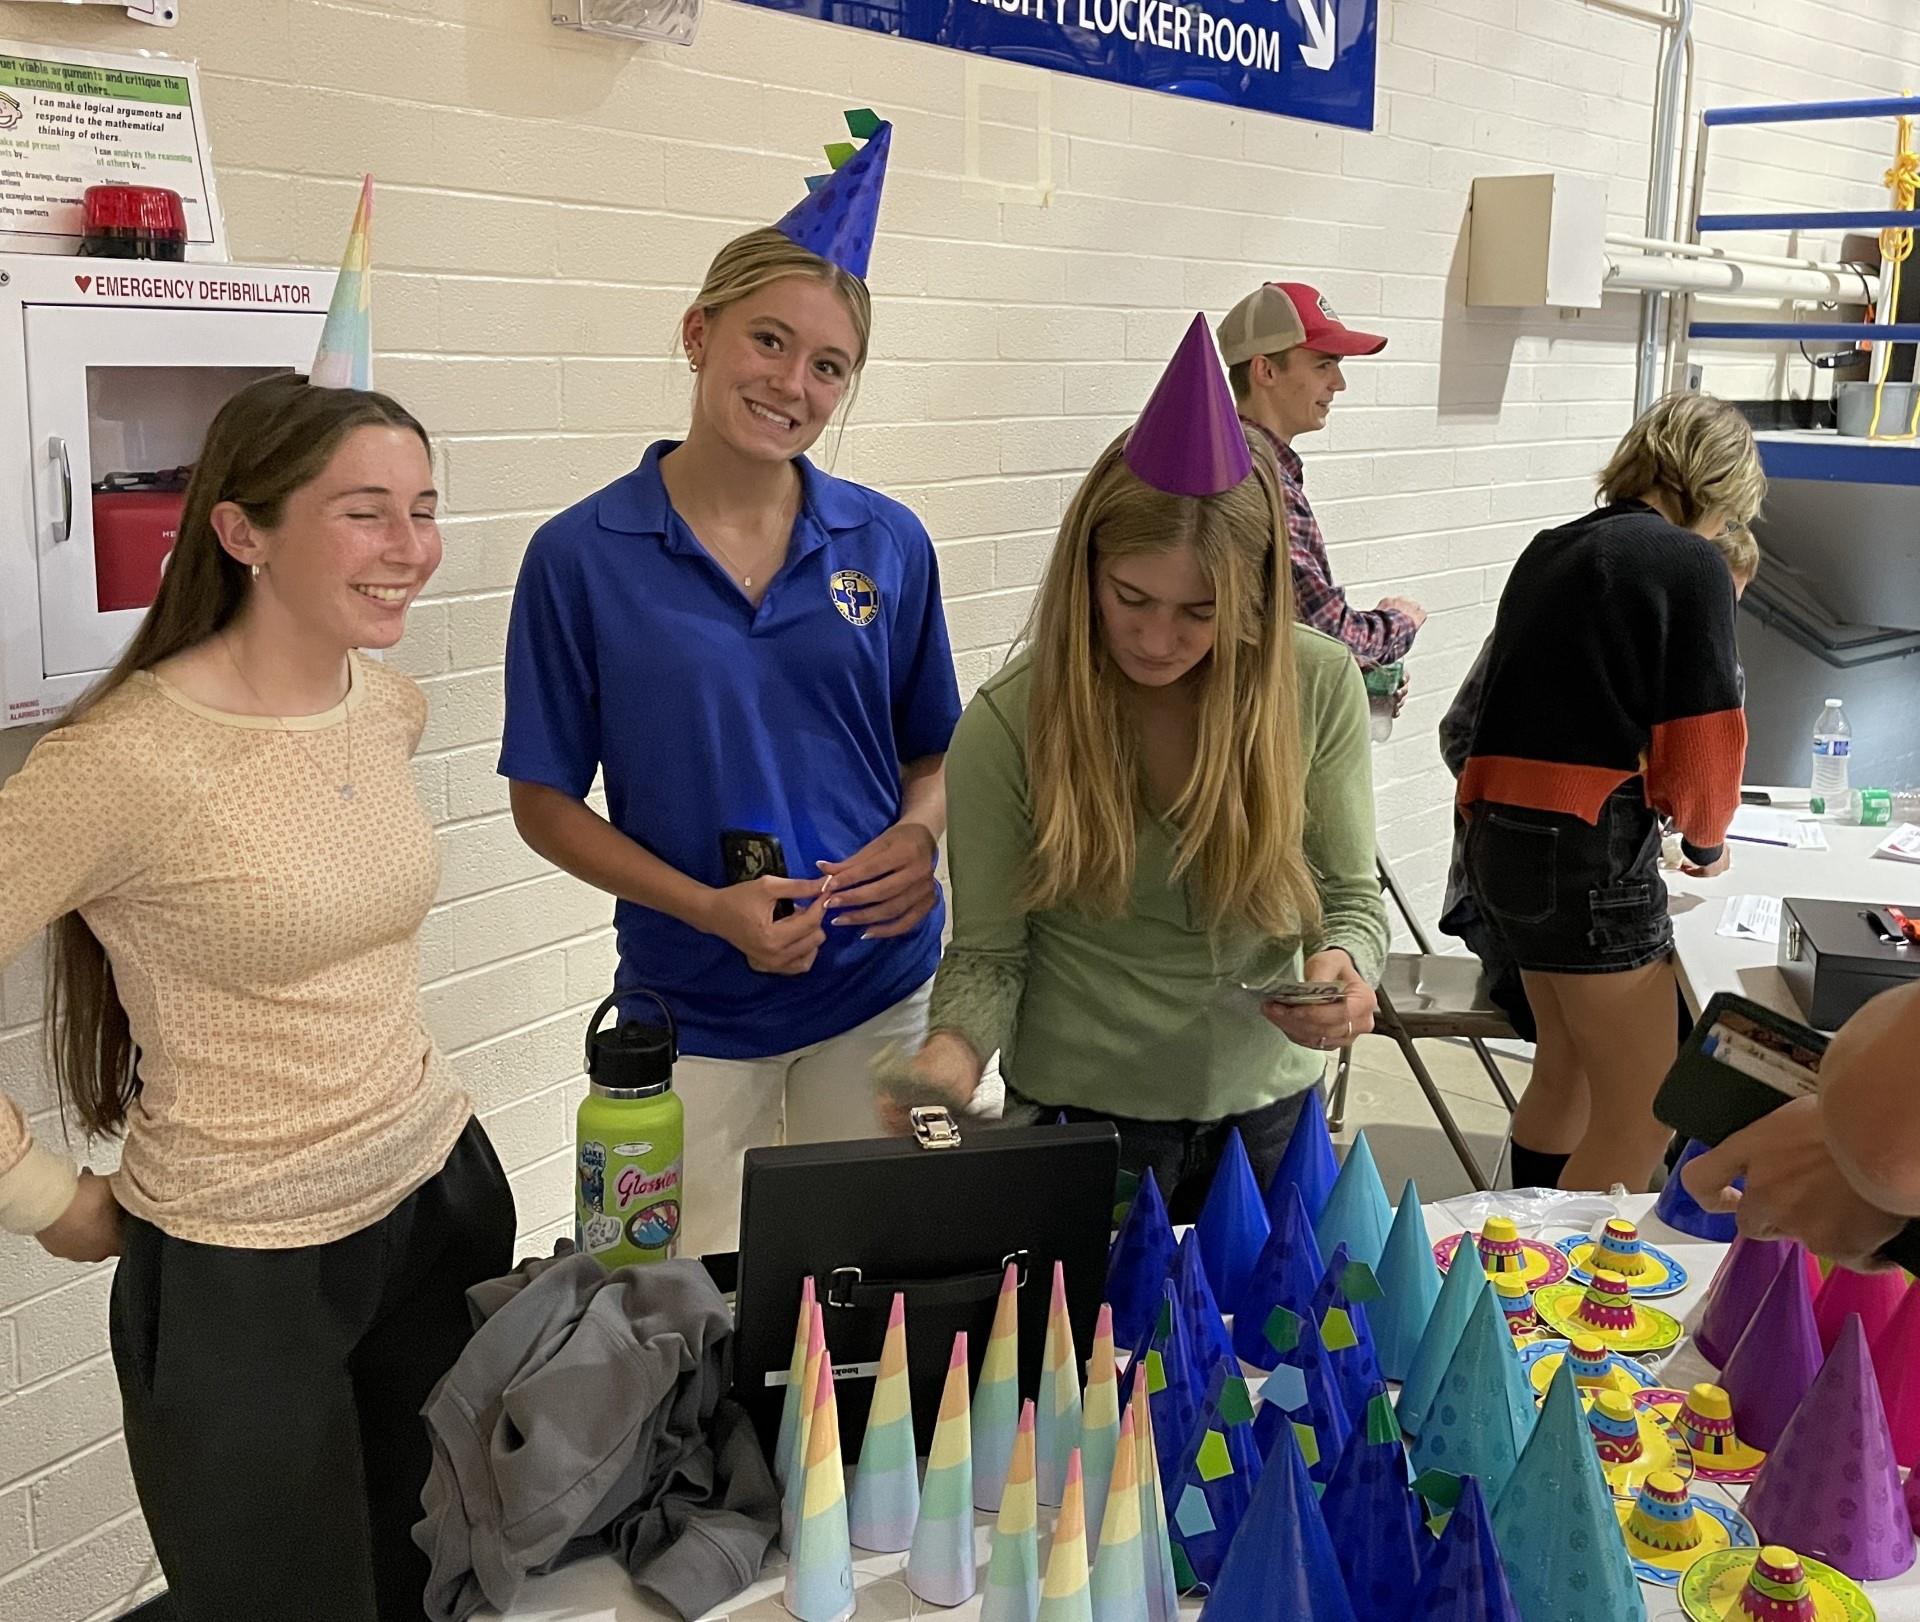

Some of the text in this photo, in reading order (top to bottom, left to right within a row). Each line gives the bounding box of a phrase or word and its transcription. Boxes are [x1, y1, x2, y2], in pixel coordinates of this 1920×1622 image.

[1078, 0, 1191, 53] LOCKER
[1198, 12, 1280, 73] ROOM
[15, 76, 62, 91] reasoning
[65, 81, 74, 91] of
[19, 61, 48, 74] viable
[51, 66, 103, 81] arguments
[106, 72, 122, 84] and
[125, 75, 161, 88] critique
[164, 78, 179, 89] the
[33, 95, 182, 120] I can make logical arguments and
[36, 112, 165, 132] respond to the mathematical
[38, 125, 75, 140] thinking
[79, 129, 88, 139] of
[16, 139, 29, 148] and
[32, 141, 60, 151] present
[113, 148, 142, 159] analyze
[144, 150, 156, 160] the
[107, 159, 130, 169] others
[96, 276, 311, 304] EMERGENCY DEFIBRILLATOR
